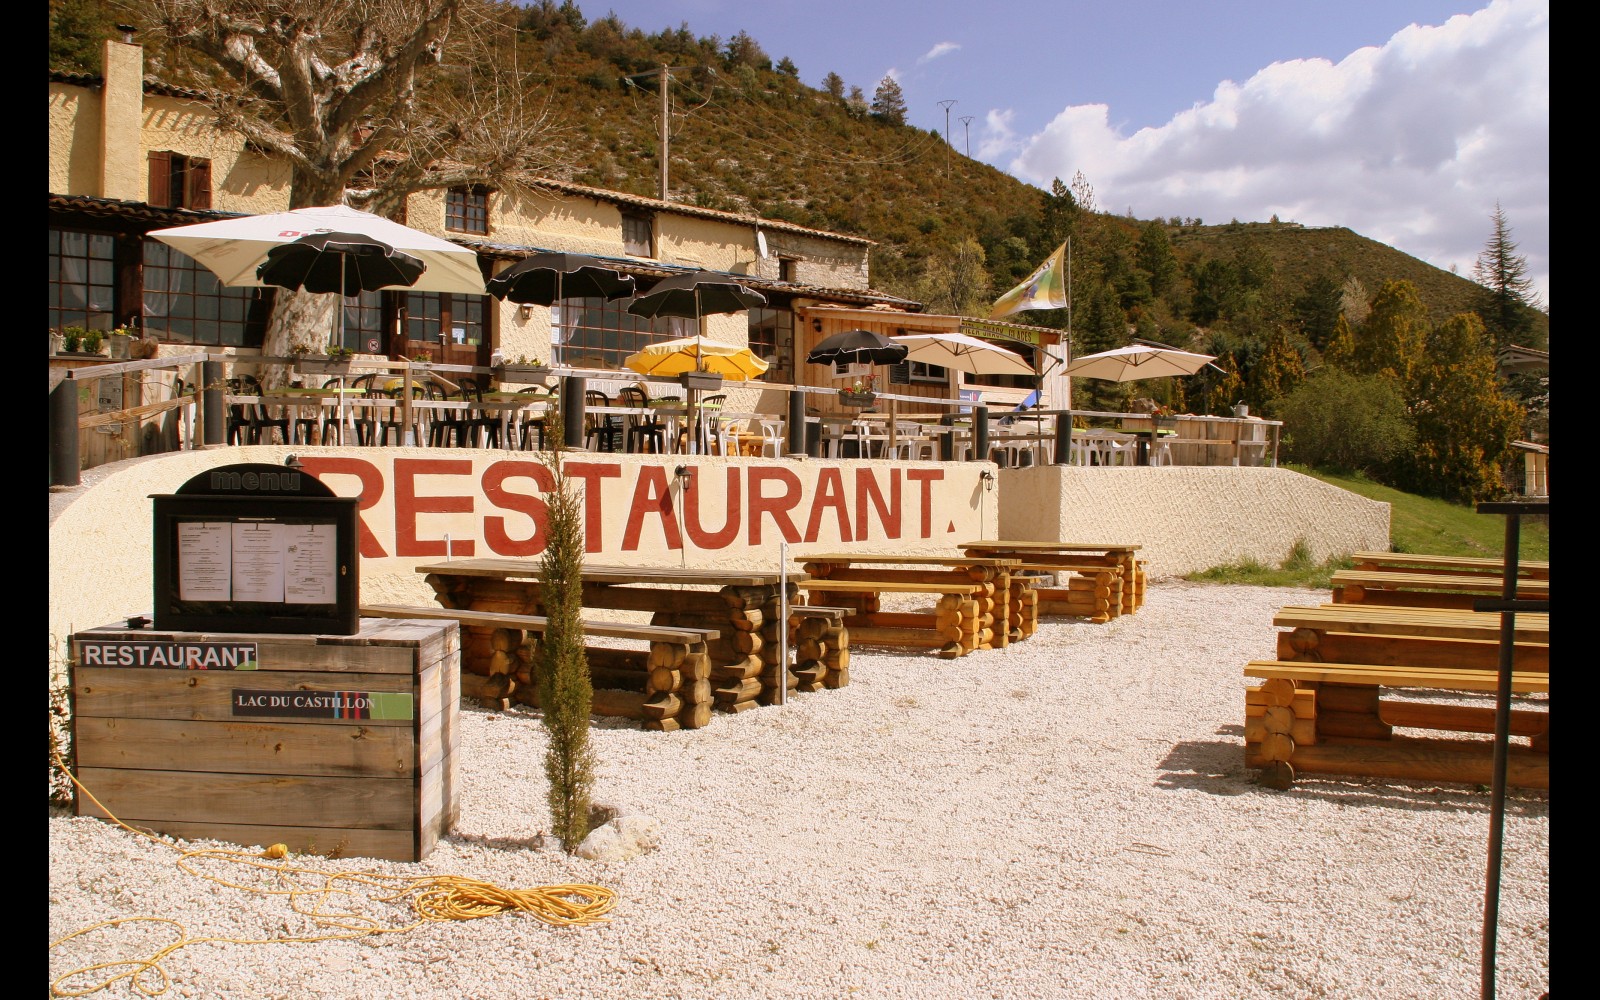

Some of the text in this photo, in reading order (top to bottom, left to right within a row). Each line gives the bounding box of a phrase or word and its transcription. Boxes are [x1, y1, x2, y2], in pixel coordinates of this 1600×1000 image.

[211, 471, 301, 490] menu
[85, 645, 254, 667] RESTAURANT
[239, 695, 375, 709] LAC DU CASTILLON
